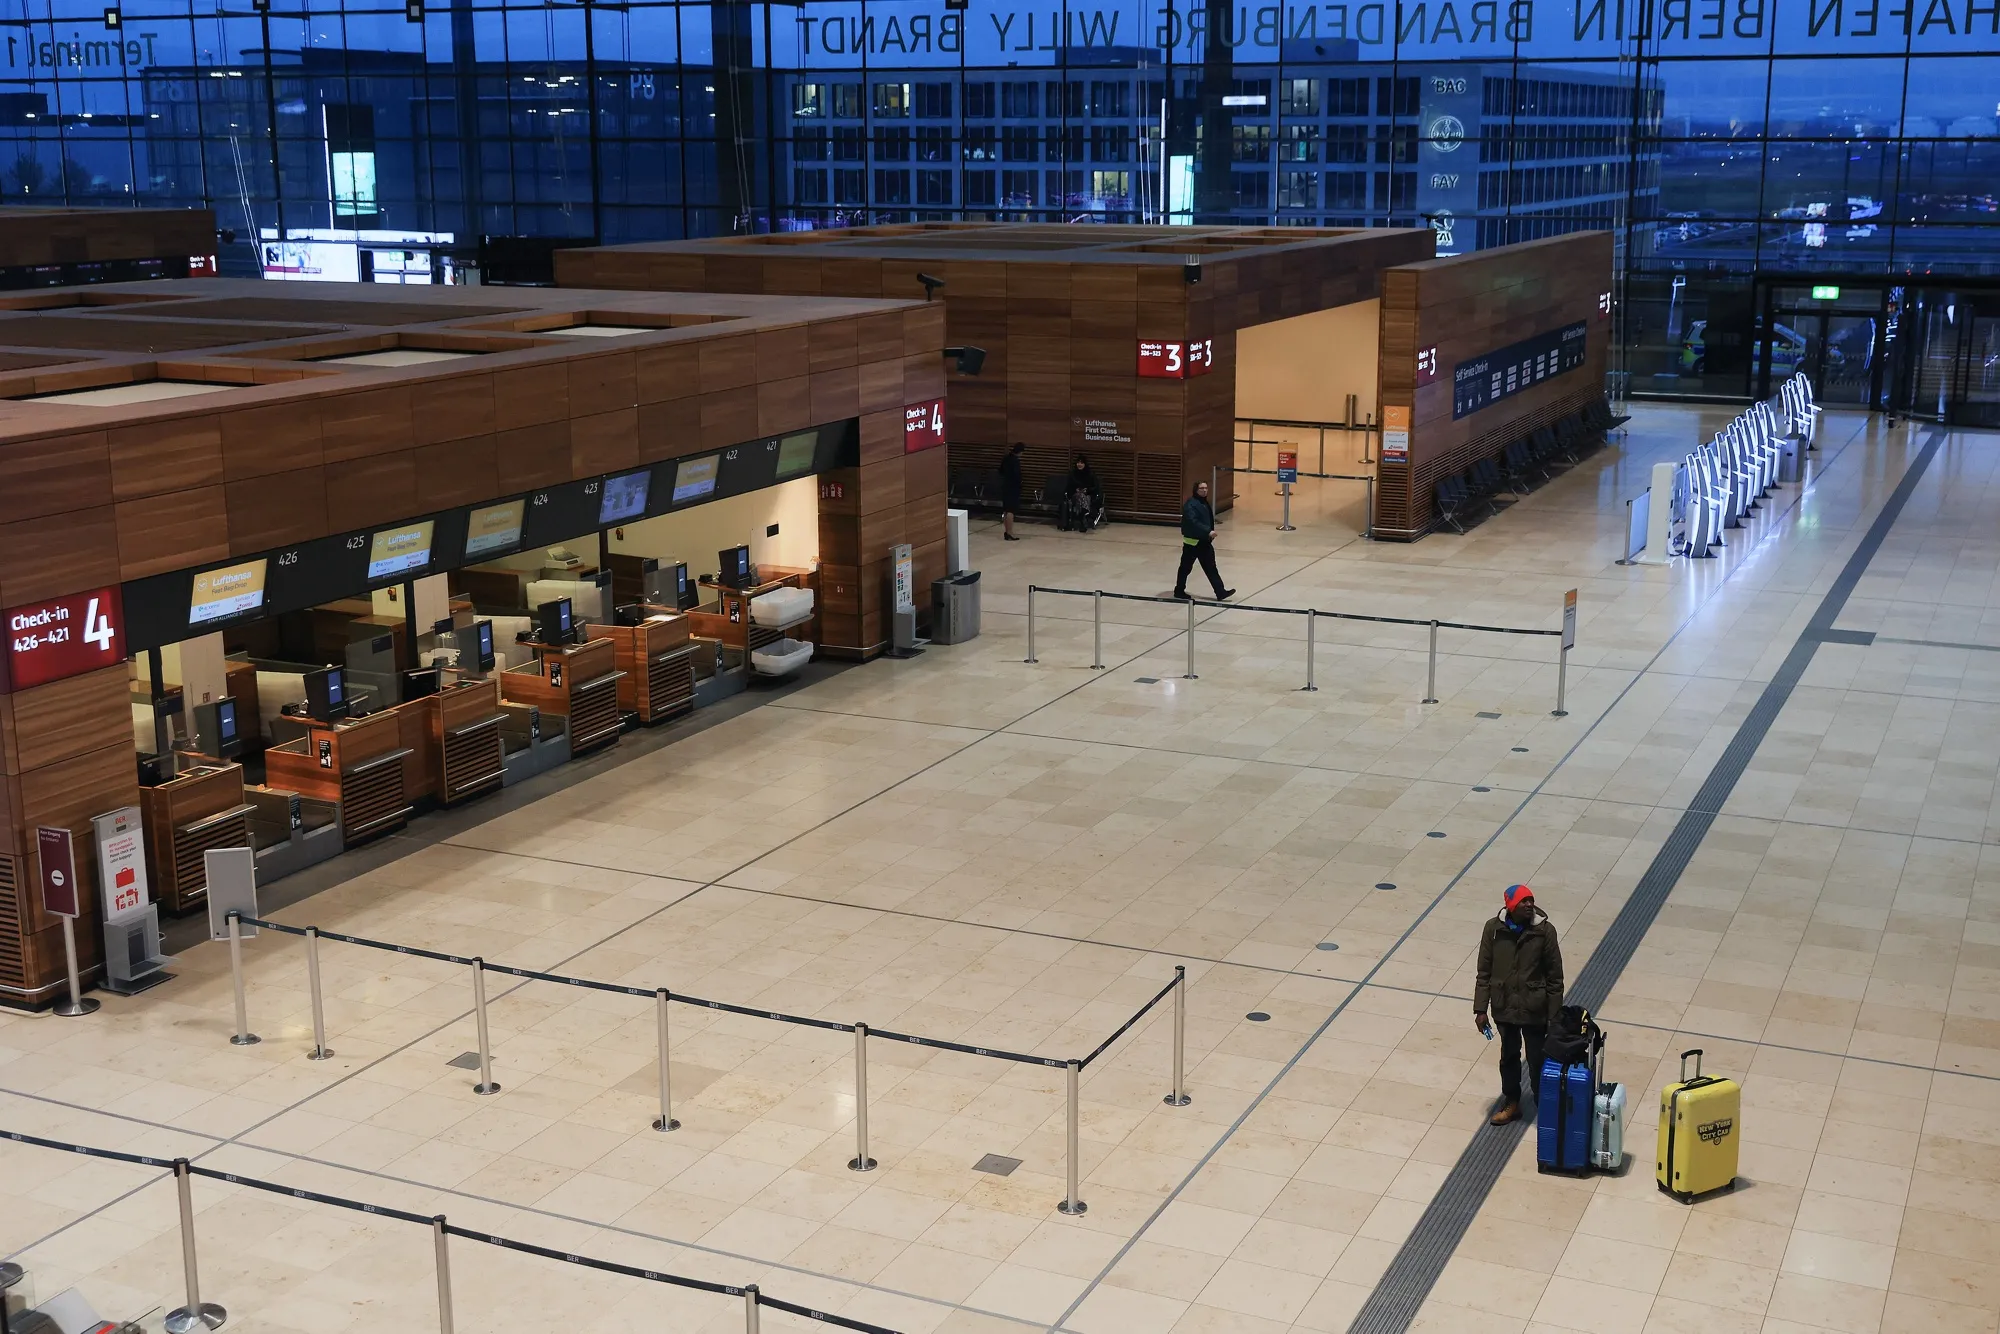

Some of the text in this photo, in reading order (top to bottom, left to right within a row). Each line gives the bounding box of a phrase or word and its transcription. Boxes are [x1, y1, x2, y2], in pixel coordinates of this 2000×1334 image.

[209, 255, 217, 272] 1
[1165, 344, 1181, 371] 3
[1204, 339, 1212, 367] 3
[1429, 347, 1437, 376] 3
[906, 406, 927, 419] Check-in
[931, 403, 943, 436] 4
[1113, 435, 1131, 443] Class
[766, 441, 777, 451] 421
[726, 450, 738, 460] 422
[584, 482, 598, 495] 423
[533, 493, 549, 506] 424
[346, 535, 365, 550] 425
[387, 531, 422, 546] Lufthansa
[278, 551, 298, 566] 426
[212, 571, 252, 587] Lufthansa
[11, 605, 70, 631] Check-in
[83, 597, 115, 651] 4
[115, 815, 127, 825] BER
[909, 1036, 920, 1044] BER
[1044, 1059, 1056, 1067] BER
[11, 1133, 22, 1141] BER
[75, 1146, 87, 1154] BER
[141, 1157, 153, 1165] BER
[225, 1174, 237, 1182] BER
[293, 1189, 305, 1198] BER
[363, 1204, 375, 1213] BER
[490, 1236, 503, 1245] BER
[566, 1254, 579, 1263] BER
[645, 1271, 658, 1280] BER
[725, 1286, 739, 1295] BER
[810, 1310, 824, 1320] BER
